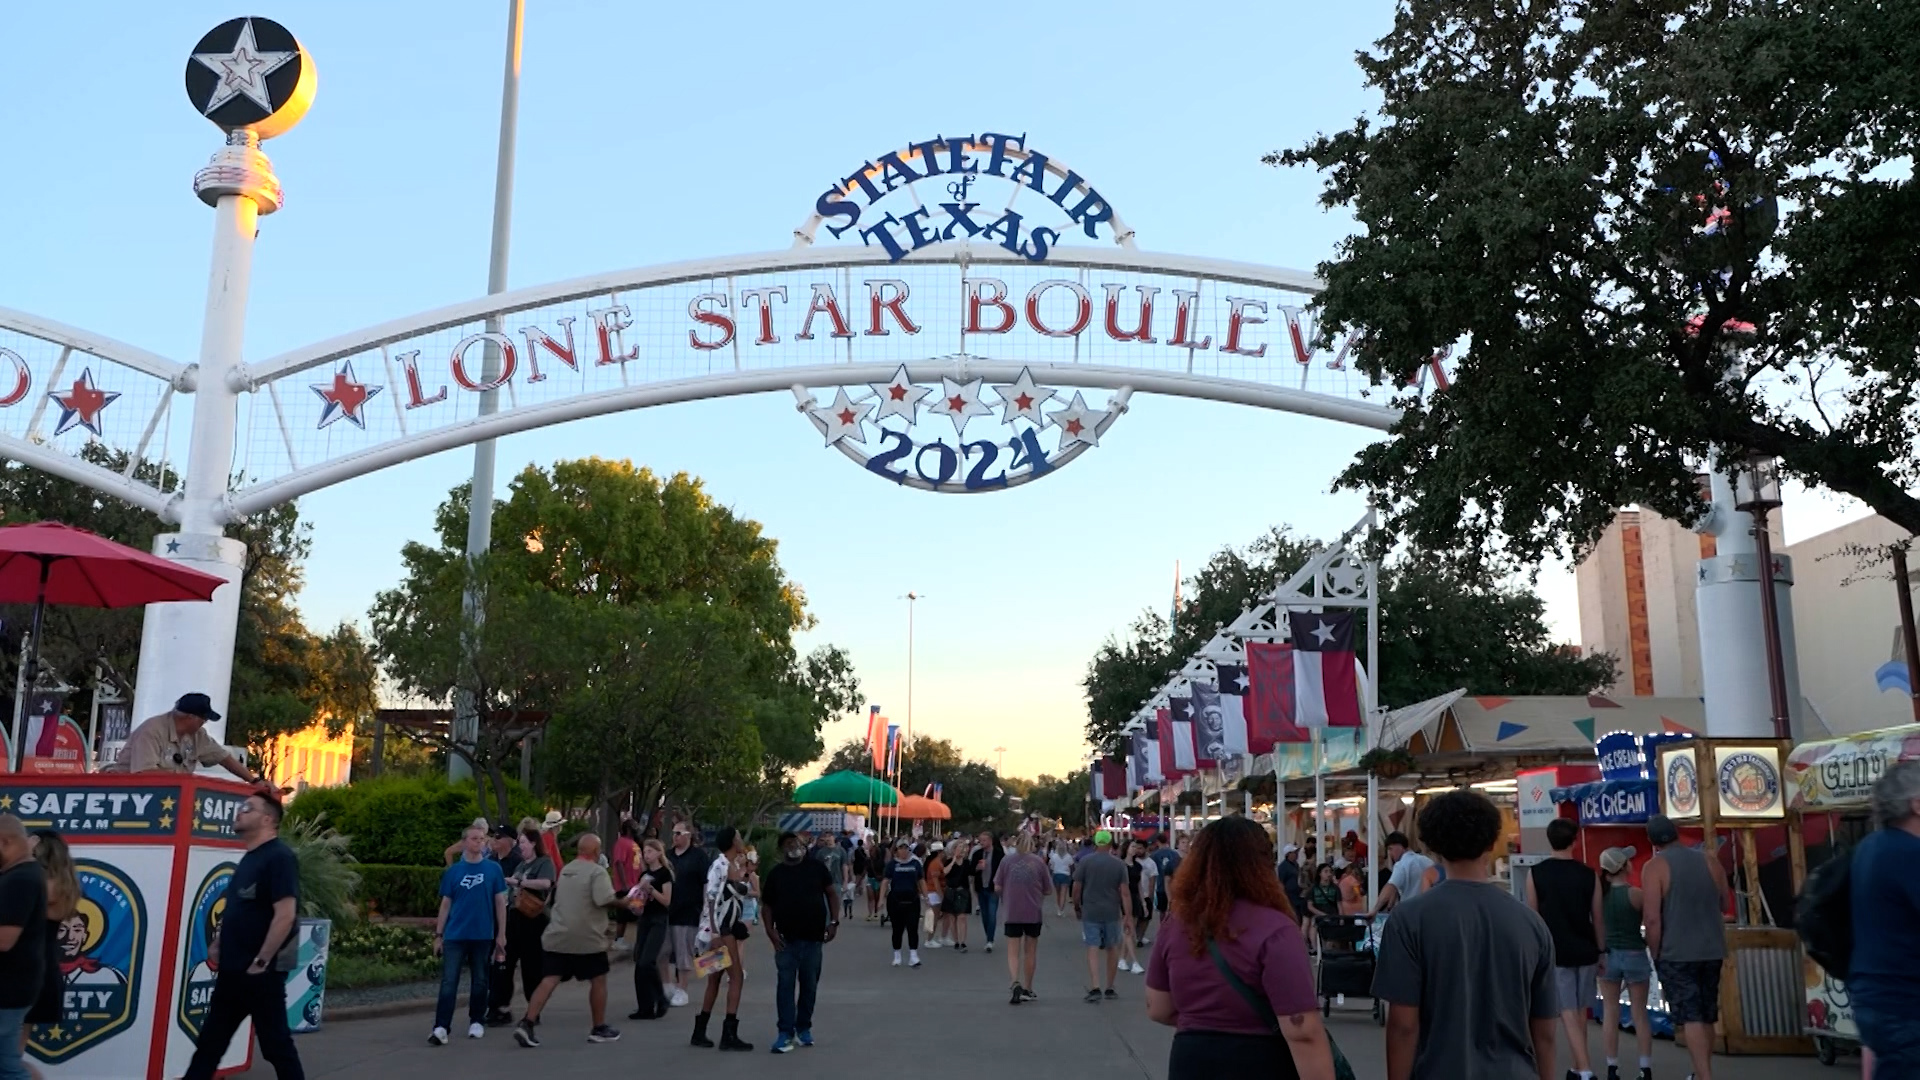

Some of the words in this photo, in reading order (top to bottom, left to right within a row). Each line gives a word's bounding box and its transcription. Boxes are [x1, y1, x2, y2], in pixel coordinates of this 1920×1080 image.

[816, 133, 979, 239] STATE
[979, 132, 1114, 239] FAIR
[946, 174, 977, 202] of
[858, 202, 1061, 263] TEXAS
[395, 303, 640, 410] LONE
[688, 279, 922, 352] STAR
[865, 427, 1056, 490] 2024
[1601, 753, 1615, 772] ICE
[18, 792, 153, 815] SAFETY
[1581, 797, 1600, 819] ICE
[1601, 789, 1646, 817] CREAM
[57, 818, 109, 830] TEAM
[81, 875, 95, 884] OF
[99, 880, 128, 909] TEXAS
